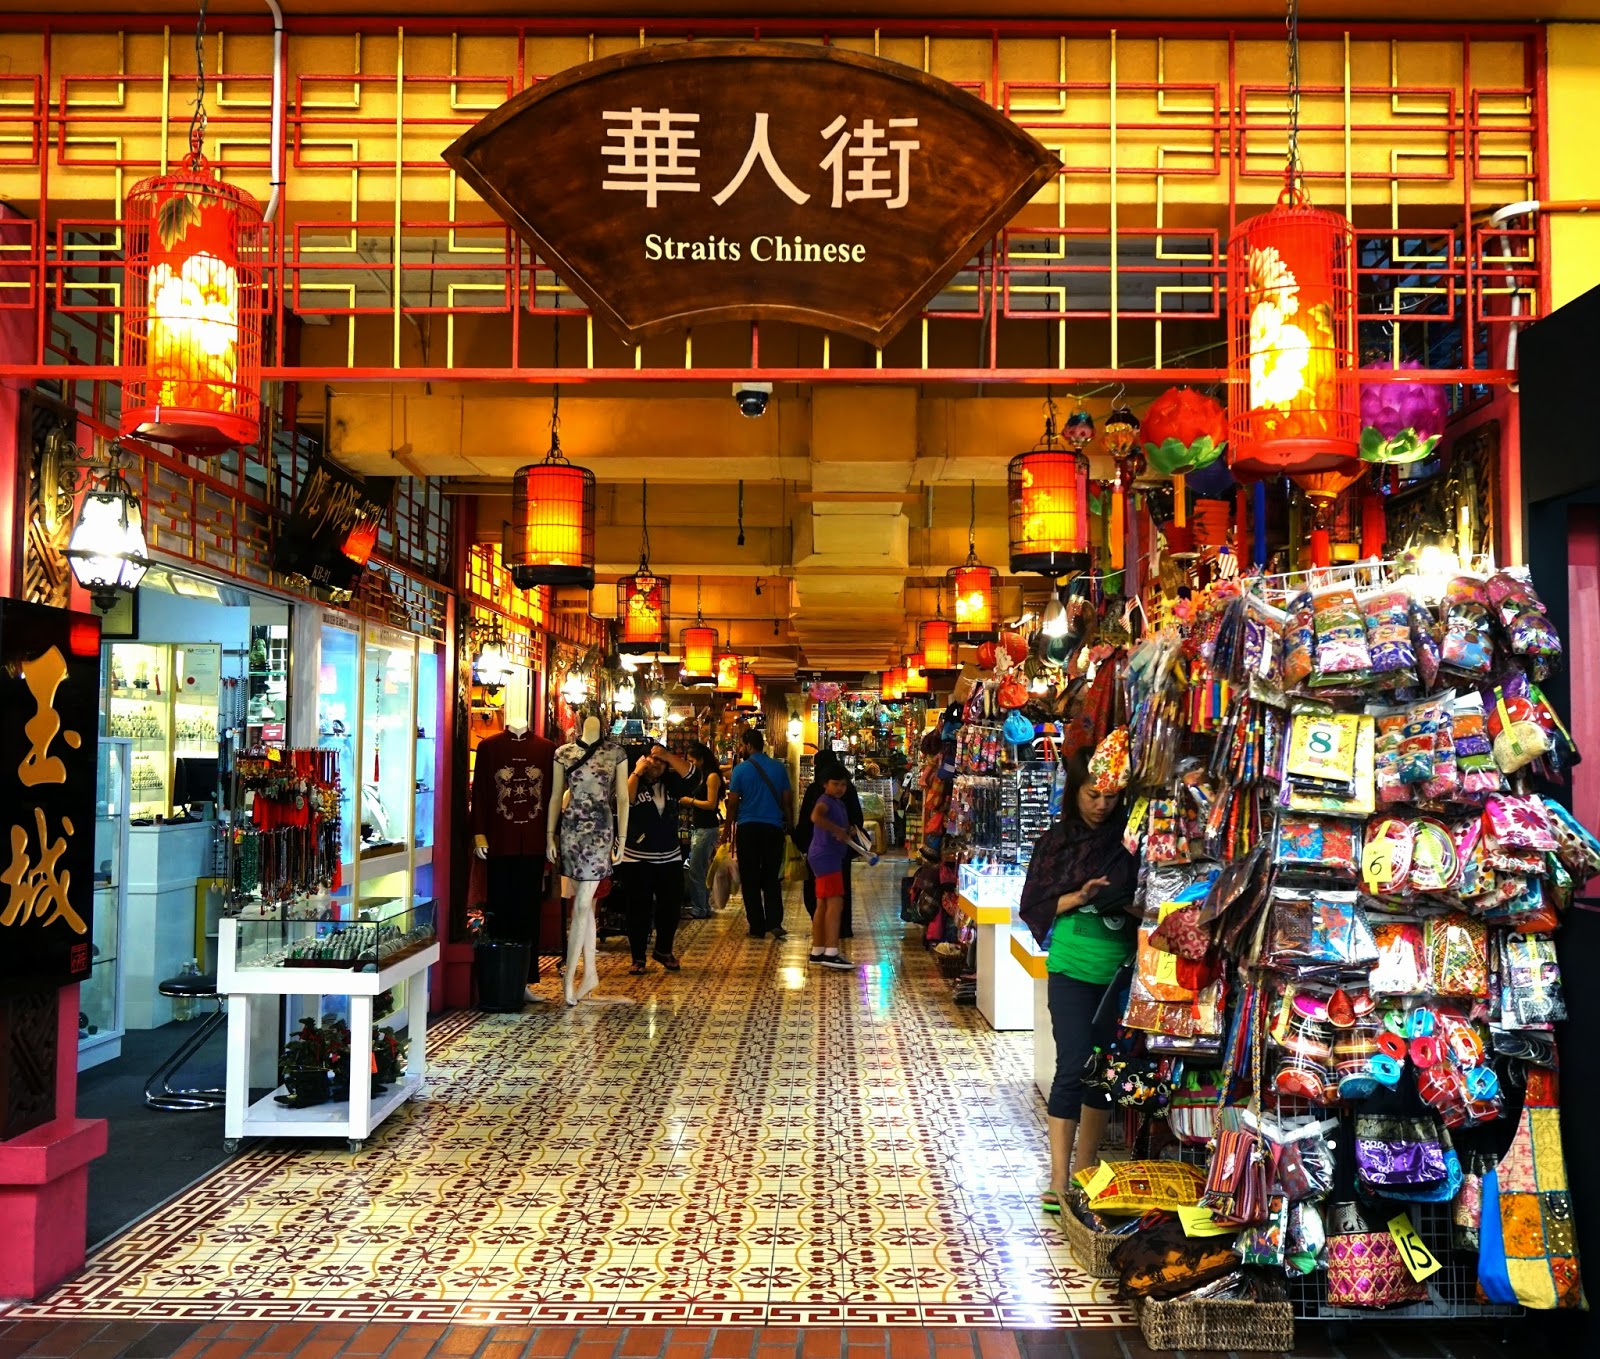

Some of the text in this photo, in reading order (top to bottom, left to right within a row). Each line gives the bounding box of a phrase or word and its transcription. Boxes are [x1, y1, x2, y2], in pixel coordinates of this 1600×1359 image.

[601, 107, 920, 210] 華人街
[645, 234, 867, 264] Straits Chinese
[1309, 731, 1332, 753] 8
[0, 645, 88, 935] 玉城
[1369, 855, 1385, 876] 6
[1161, 961, 1177, 980] 5
[1400, 1231, 1433, 1271] 15
